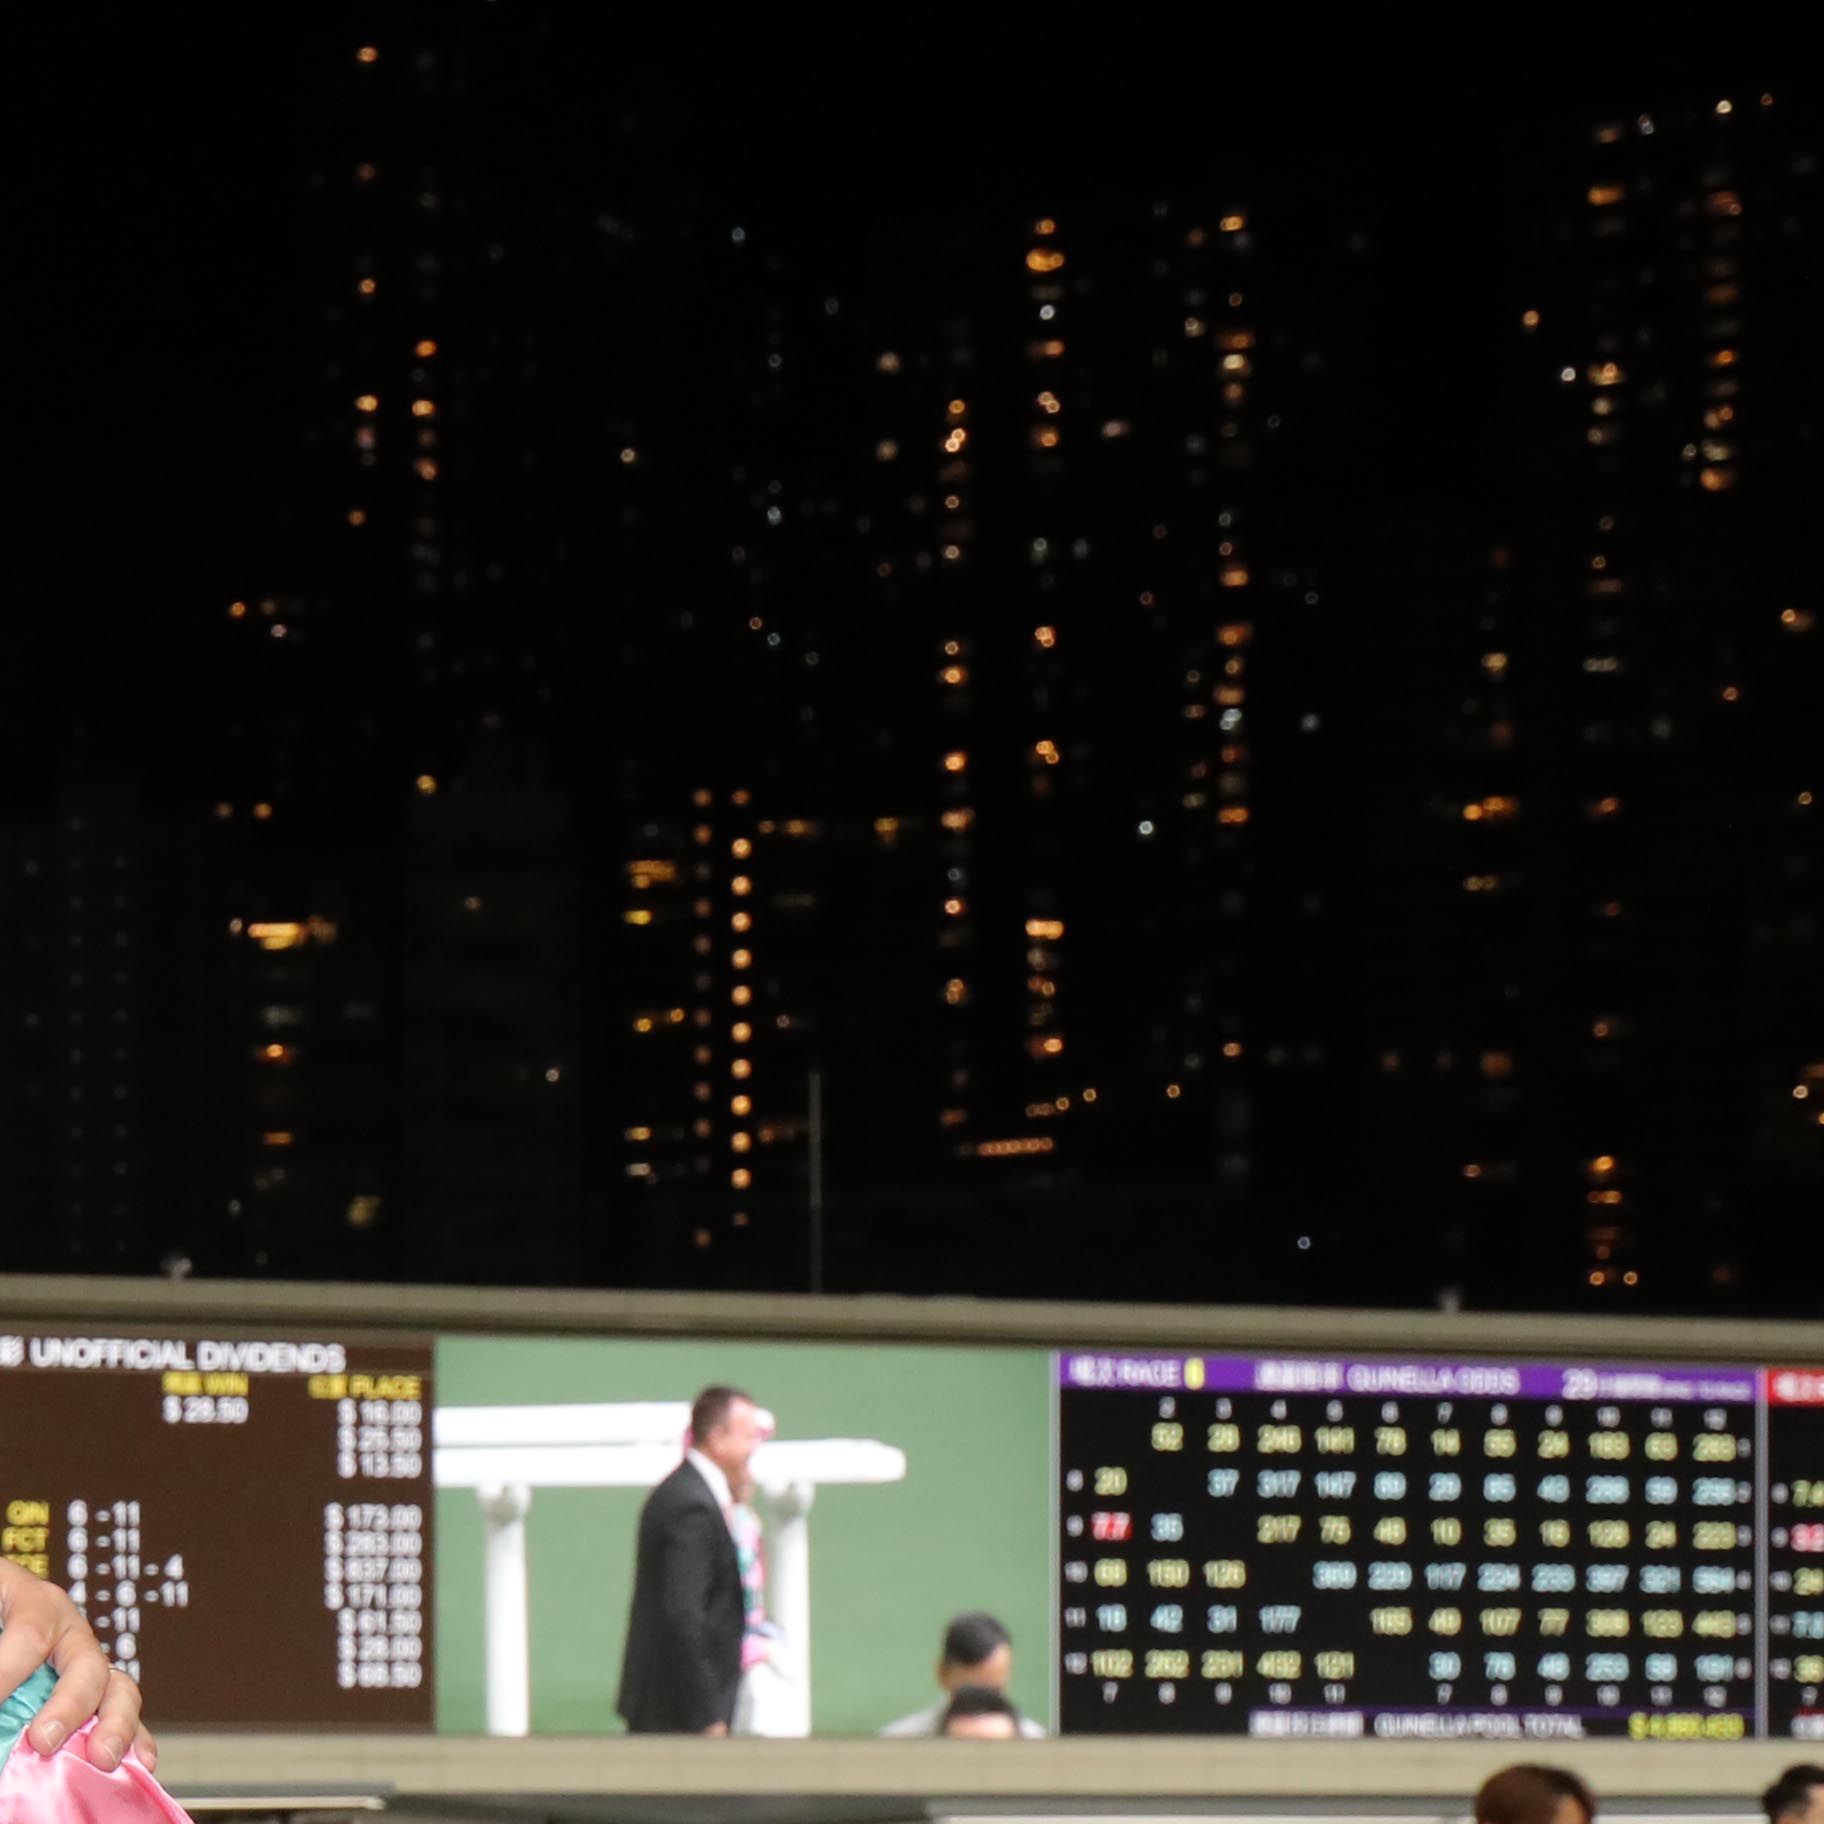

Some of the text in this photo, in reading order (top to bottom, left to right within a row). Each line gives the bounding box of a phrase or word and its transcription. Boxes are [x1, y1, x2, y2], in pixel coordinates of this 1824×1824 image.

[29, 1337, 195, 1370] UNOFFICIAL
[197, 1342, 347, 1373] DIVIDENDS
[349, 1376, 422, 1400] PLACE
